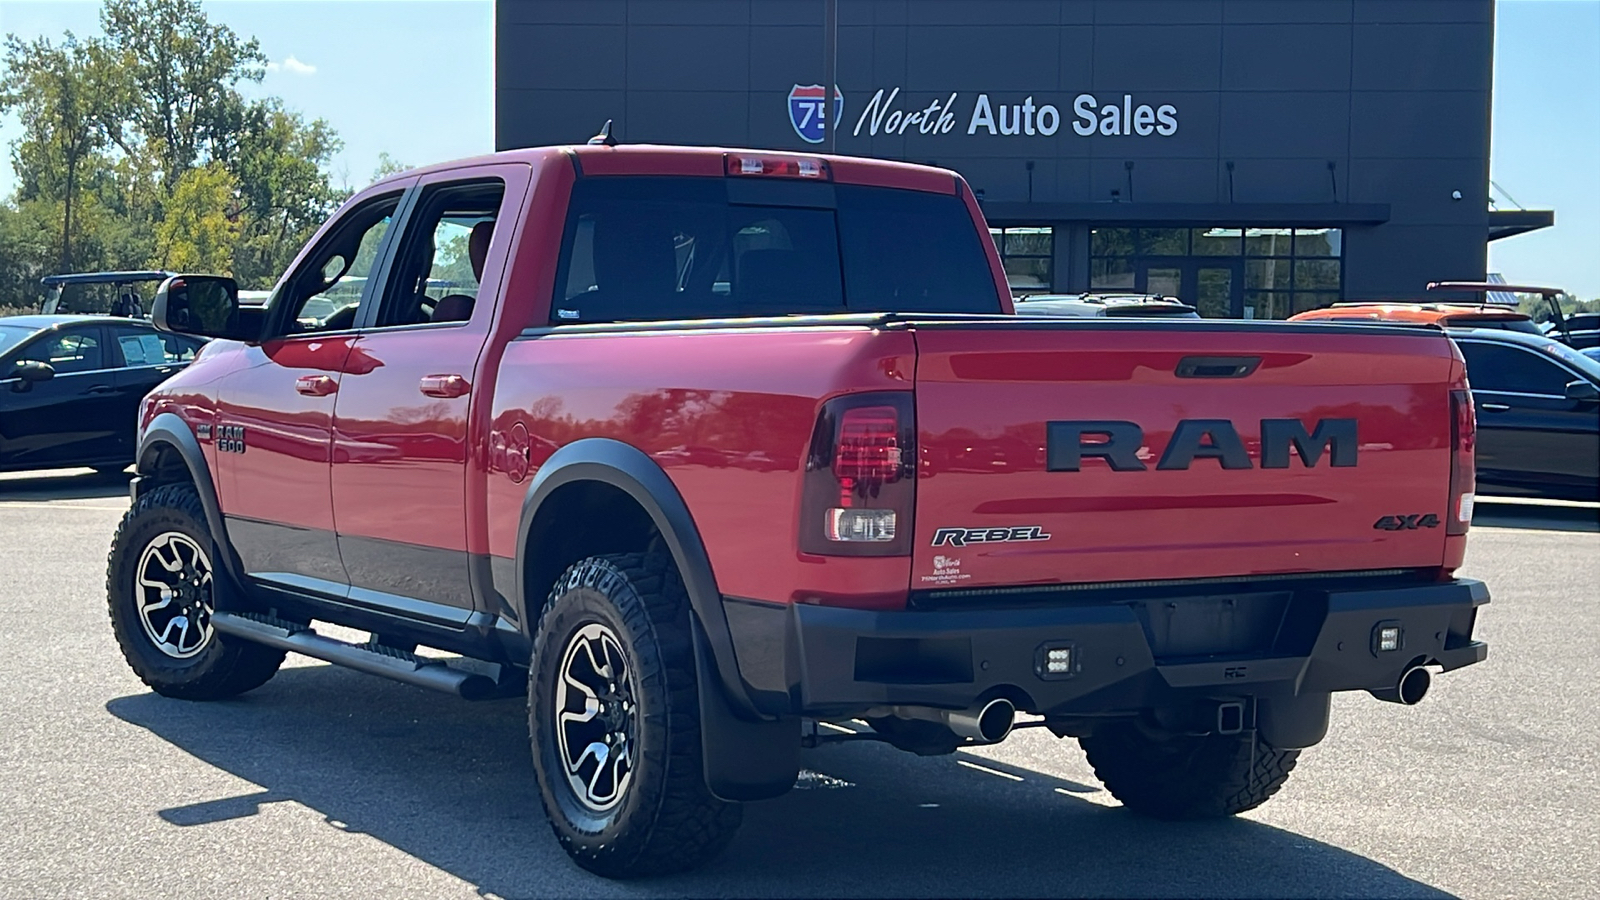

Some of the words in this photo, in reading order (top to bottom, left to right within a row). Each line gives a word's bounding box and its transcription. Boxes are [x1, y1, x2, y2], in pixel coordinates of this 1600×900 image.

[853, 87, 957, 136] North
[967, 94, 1060, 136] Auto
[1072, 94, 1178, 136] Sales
[216, 424, 244, 440] RAM
[1046, 418, 1358, 472] RAM
[931, 526, 1052, 547] REBEL
